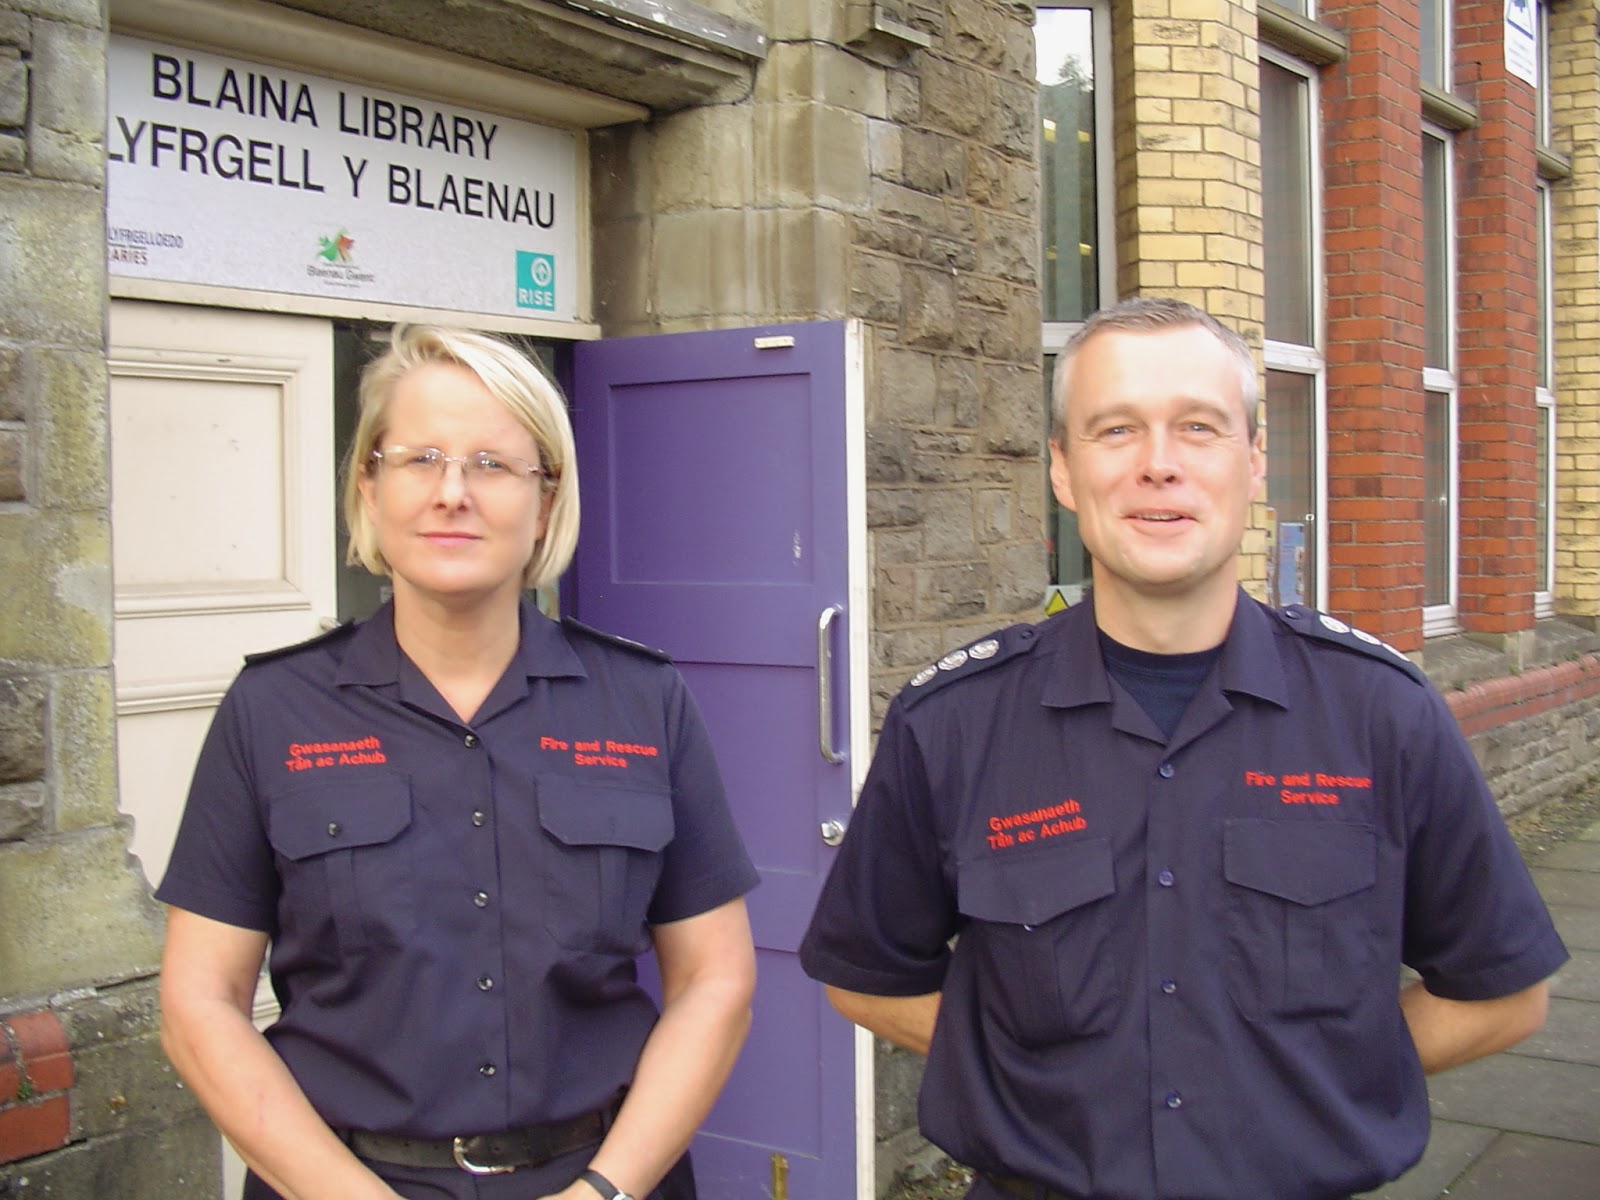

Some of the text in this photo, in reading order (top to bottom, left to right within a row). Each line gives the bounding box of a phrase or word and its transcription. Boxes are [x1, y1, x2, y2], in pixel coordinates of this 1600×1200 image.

[152, 53, 498, 160] BLAINA LIBRARY
[343, 156, 368, 198] Y
[388, 164, 555, 229] BLAENAU
[519, 287, 553, 307] RISE
[540, 736, 658, 757] Fire and Rescue
[315, 756, 335, 768] ac
[338, 750, 387, 766] Achub
[574, 753, 629, 768] Service
[1244, 770, 1373, 789] Fire and Rescue
[1280, 788, 1341, 805] Service
[989, 798, 1081, 832] Gwasanaeth
[1017, 829, 1036, 843] ac
[1040, 815, 1087, 840] Achub
